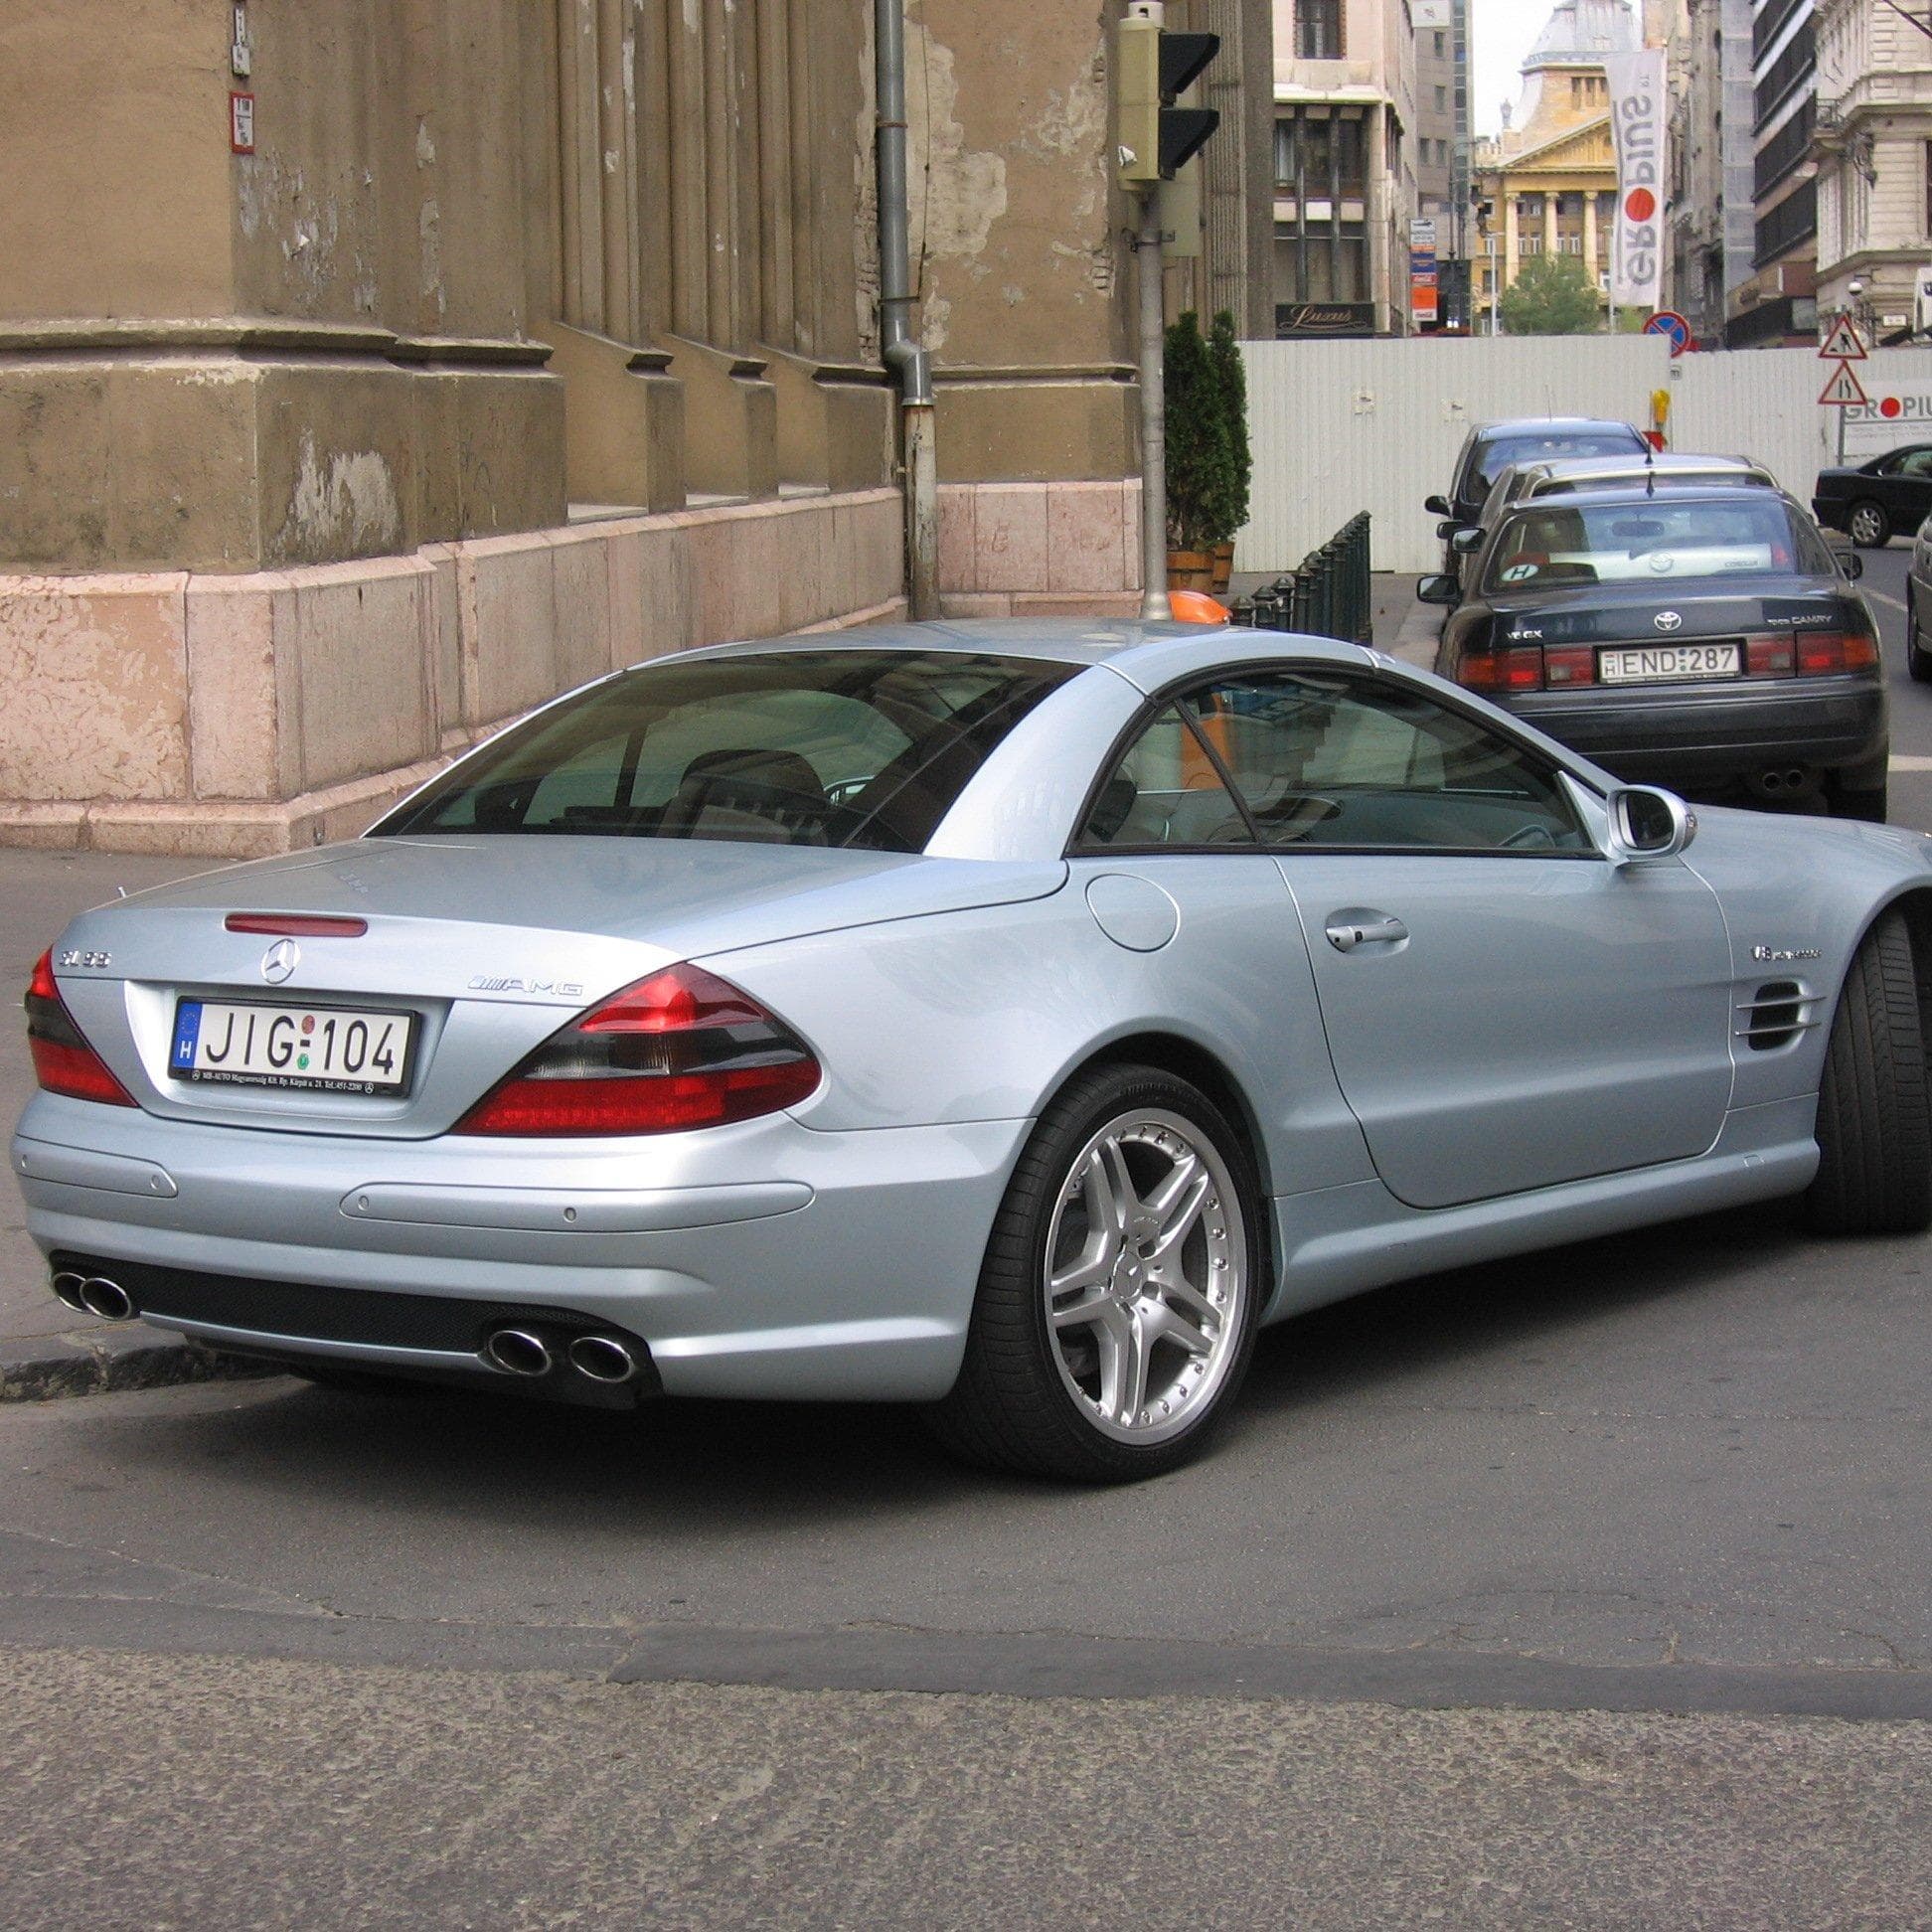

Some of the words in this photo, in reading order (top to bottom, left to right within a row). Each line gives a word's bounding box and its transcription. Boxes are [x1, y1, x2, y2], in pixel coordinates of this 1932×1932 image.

[1284, 303, 1359, 330] Luxus
[1509, 565, 1530, 579] H
[1605, 665, 1615, 676] H
[179, 1040, 193, 1060] H
